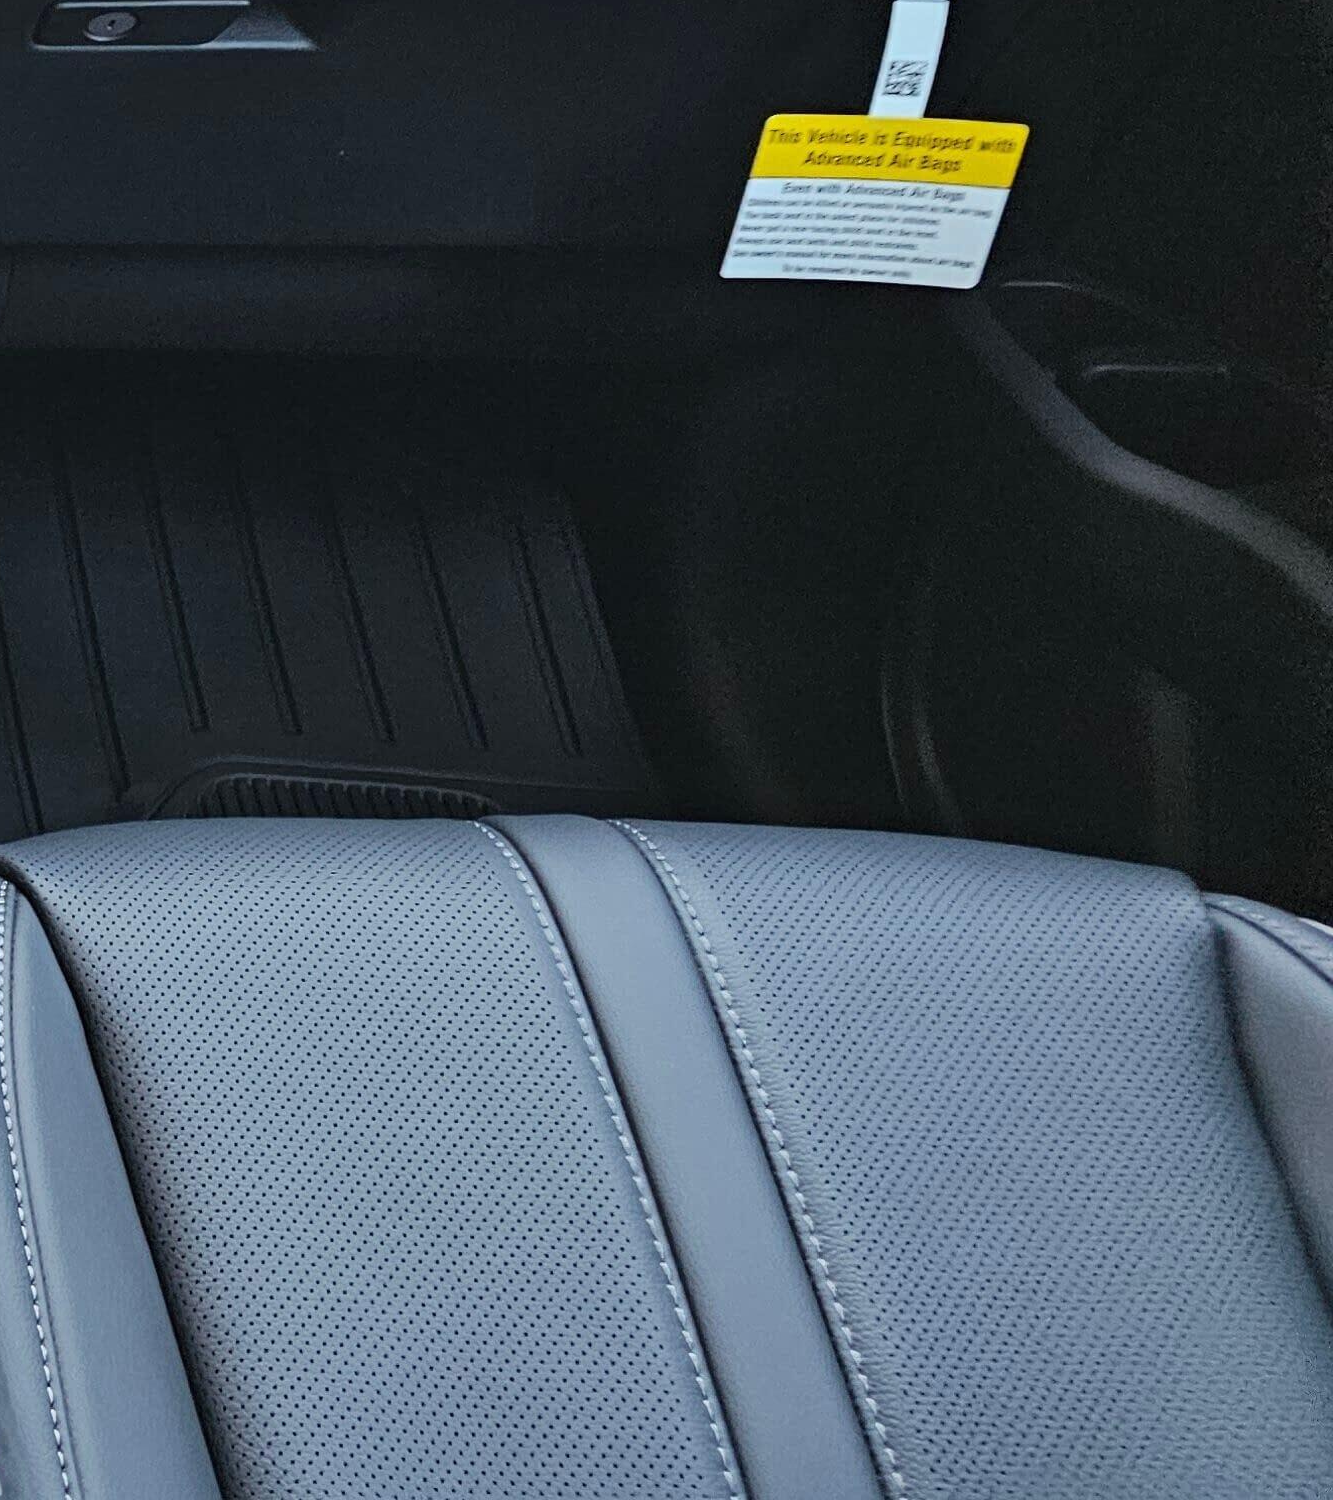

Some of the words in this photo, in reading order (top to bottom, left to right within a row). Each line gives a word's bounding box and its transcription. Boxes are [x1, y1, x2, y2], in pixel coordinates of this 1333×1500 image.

[768, 129, 801, 145] This
[807, 129, 866, 145] Vehicle
[872, 130, 887, 146] is
[891, 132, 975, 151] Equipped
[978, 137, 1017, 152] with
[801, 151, 883, 168] Advanced
[888, 153, 914, 169] Air
[919, 155, 963, 174] Bags
